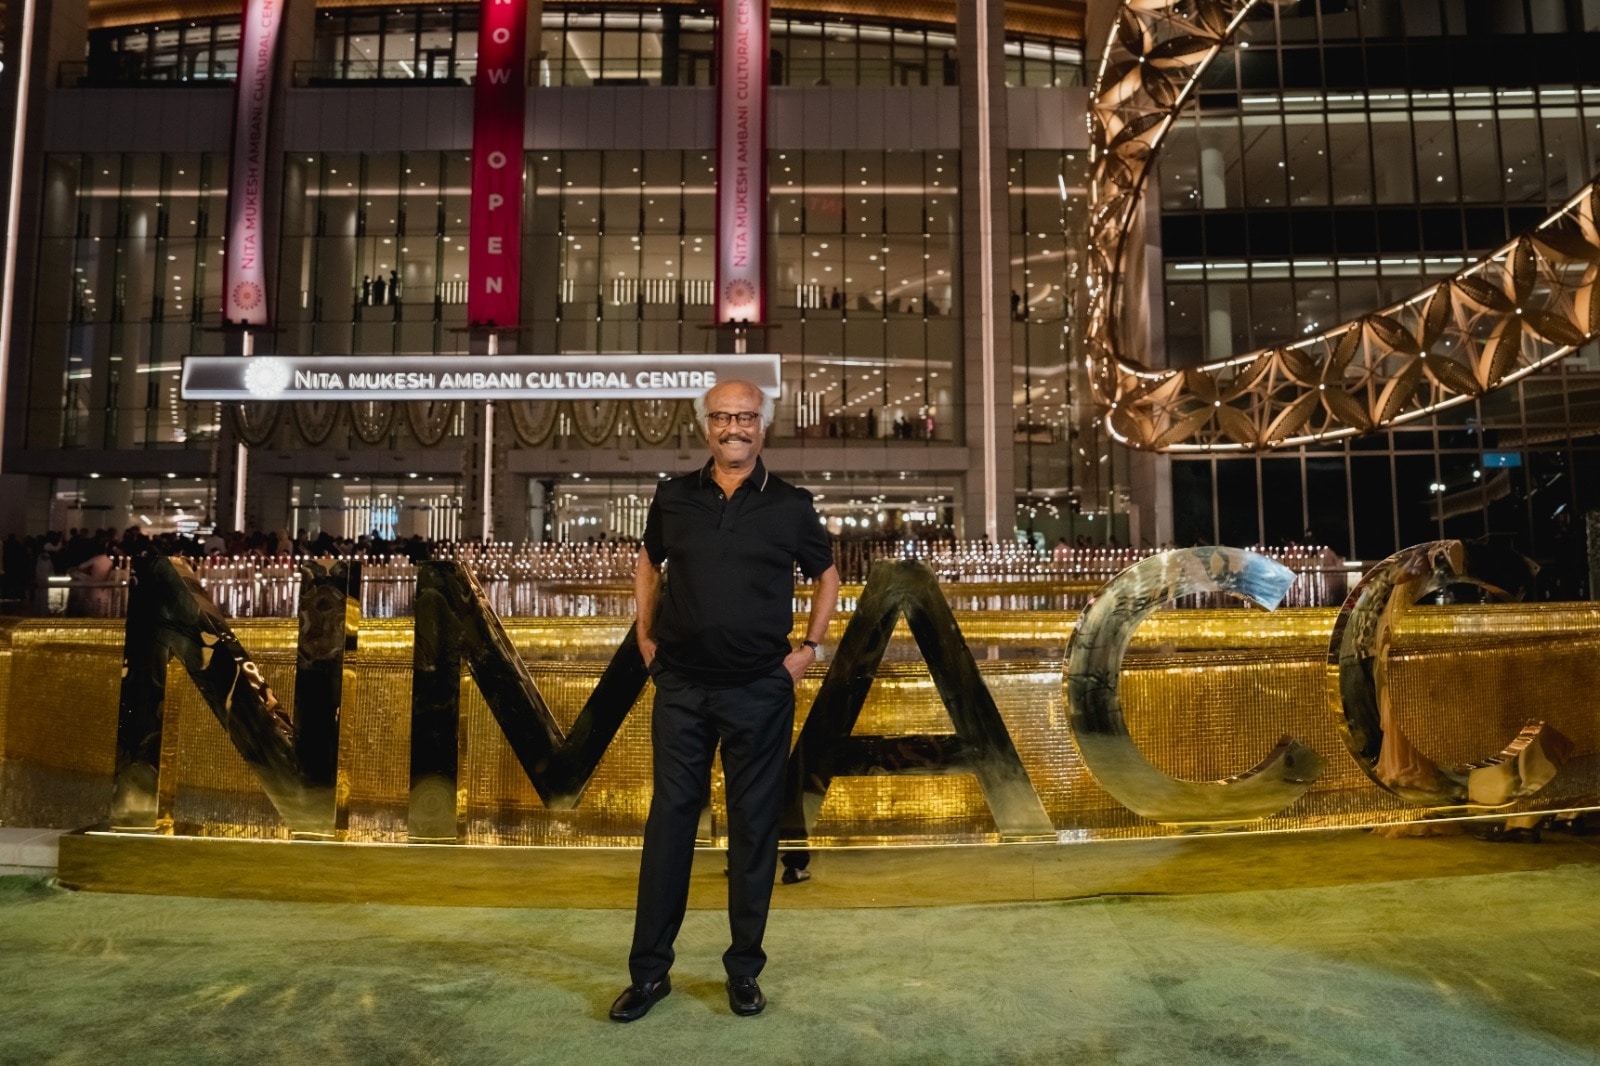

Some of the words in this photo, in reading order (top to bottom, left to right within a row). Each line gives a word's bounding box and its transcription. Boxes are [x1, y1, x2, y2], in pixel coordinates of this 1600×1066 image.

[253, 31, 271, 101] CULTURAL
[487, 0, 512, 85] OW
[737, 29, 749, 100] CULTURAL
[249, 106, 263, 164] AMBANI
[737, 106, 749, 162] AMBANI
[245, 168, 259, 230] MUKESH
[486, 151, 507, 294] OPEN
[736, 167, 748, 228] MUKESH
[241, 234, 256, 270] NITA
[734, 232, 747, 268] NITA
[295, 370, 344, 389] NITA
[349, 372, 435, 389] MUKESH
[439, 372, 523, 389] AMBANI
[525, 371, 633, 389] CULTURAL
[635, 371, 717, 388] CENTRE
[111, 540, 1558, 844] NMACC
